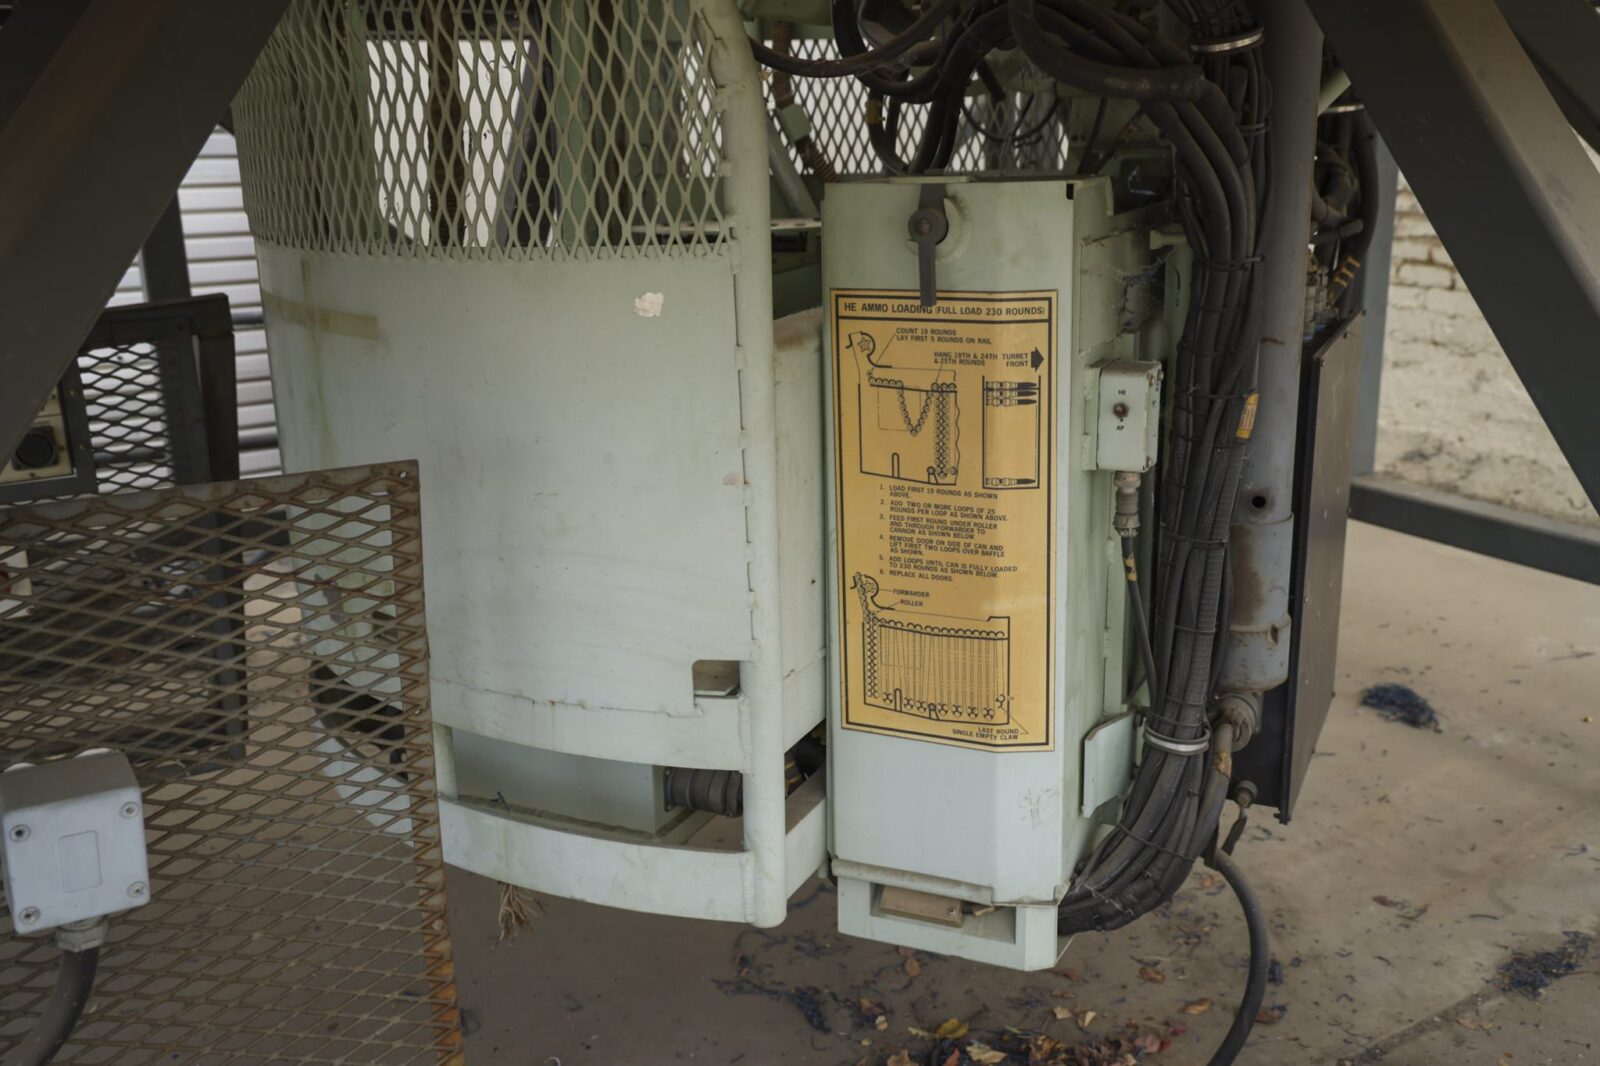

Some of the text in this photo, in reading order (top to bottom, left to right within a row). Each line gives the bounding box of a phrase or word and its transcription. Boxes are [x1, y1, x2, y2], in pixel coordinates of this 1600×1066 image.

[844, 302, 857, 312] HE
[861, 303, 889, 313] AMMO
[892, 304, 933, 314] LOADING
[960, 307, 982, 316] LOAD
[985, 307, 1002, 316] 230
[905, 522, 935, 530] THROUGH
[940, 546, 960, 554] LOOPS
[893, 588, 930, 597] FORWARDER
